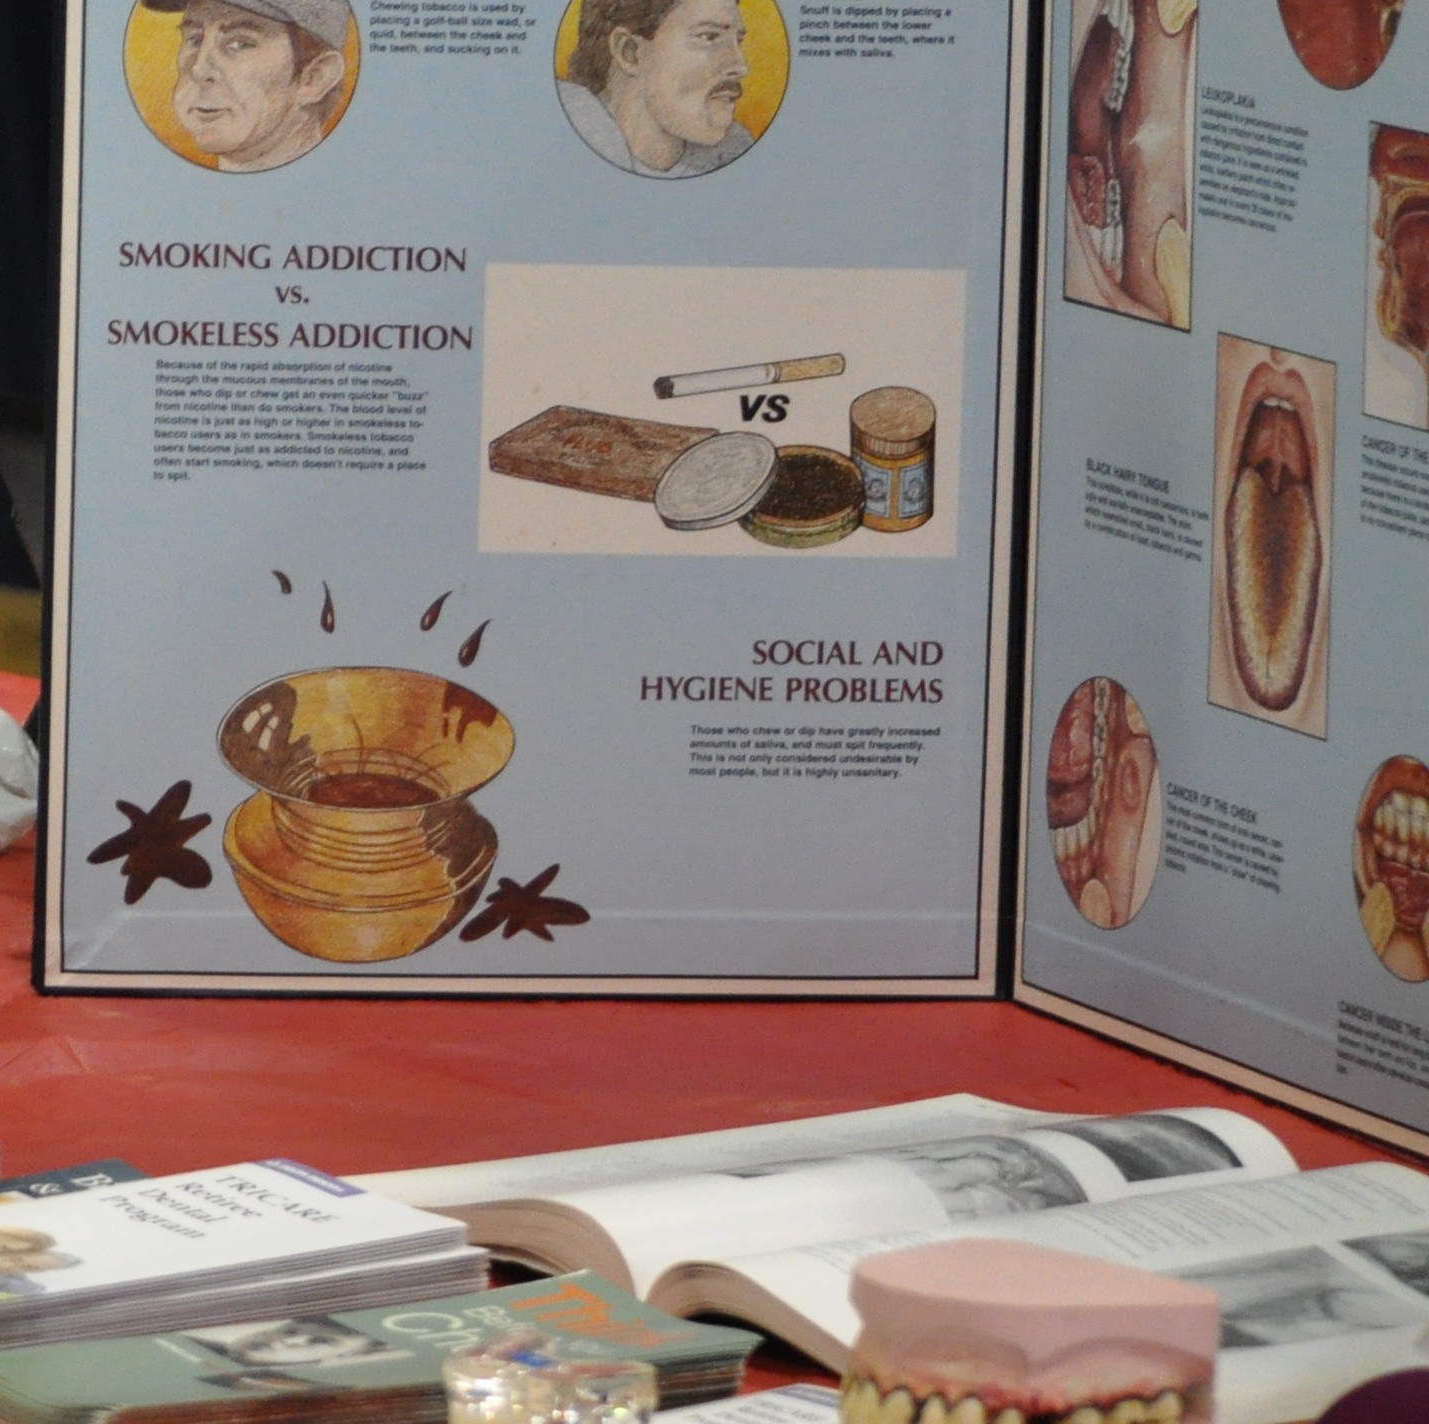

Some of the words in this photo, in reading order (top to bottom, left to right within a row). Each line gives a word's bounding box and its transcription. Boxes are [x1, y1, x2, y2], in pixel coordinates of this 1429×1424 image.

[468, 3, 479, 11] is
[481, 3, 509, 12] used
[511, 4, 525, 14] by
[832, 7, 842, 15] is
[885, 7, 899, 17] by
[471, 18, 493, 26] size
[882, 21, 899, 29] the
[449, 31, 467, 39] the
[506, 32, 527, 40] and
[835, 35, 855, 43] and
[858, 35, 875, 43] the
[948, 36, 955, 44] it
[370, 44, 387, 52] the
[424, 45, 445, 53] and
[835, 49, 857, 57] with
[119, 242, 271, 269] SMOKING
[282, 245, 466, 272] ADDICTION
[107, 320, 279, 347] SMOKELESS
[290, 323, 473, 350] ADDICTION
[739, 394, 790, 423] VS
[752, 639, 862, 666] SOCIAL
[872, 641, 944, 666] AND
[641, 676, 772, 703] HYGIENE
[785, 678, 944, 705] PROBLEMS
[727, 726, 750, 735] who
[752, 726, 781, 736] chew
[784, 728, 795, 736] or
[798, 726, 816, 738] dip
[818, 727, 845, 736] have
[740, 741, 751, 749] of
[792, 741, 813, 749] and
[815, 741, 843, 749] must
[845, 741, 866, 752] spit
[690, 753, 713, 762] This
[716, 753, 725, 762] is
[728, 753, 746, 763] not
[749, 753, 772, 765] only
[905, 755, 918, 765] by
[689, 767, 716, 776] most
[761, 767, 780, 776] but
[782, 767, 790, 776] it
[792, 768, 802, 776] is
[215, 1173, 341, 1224] TRICARE
[139, 1187, 228, 1224] Dental
[99, 1194, 207, 1240] Program
